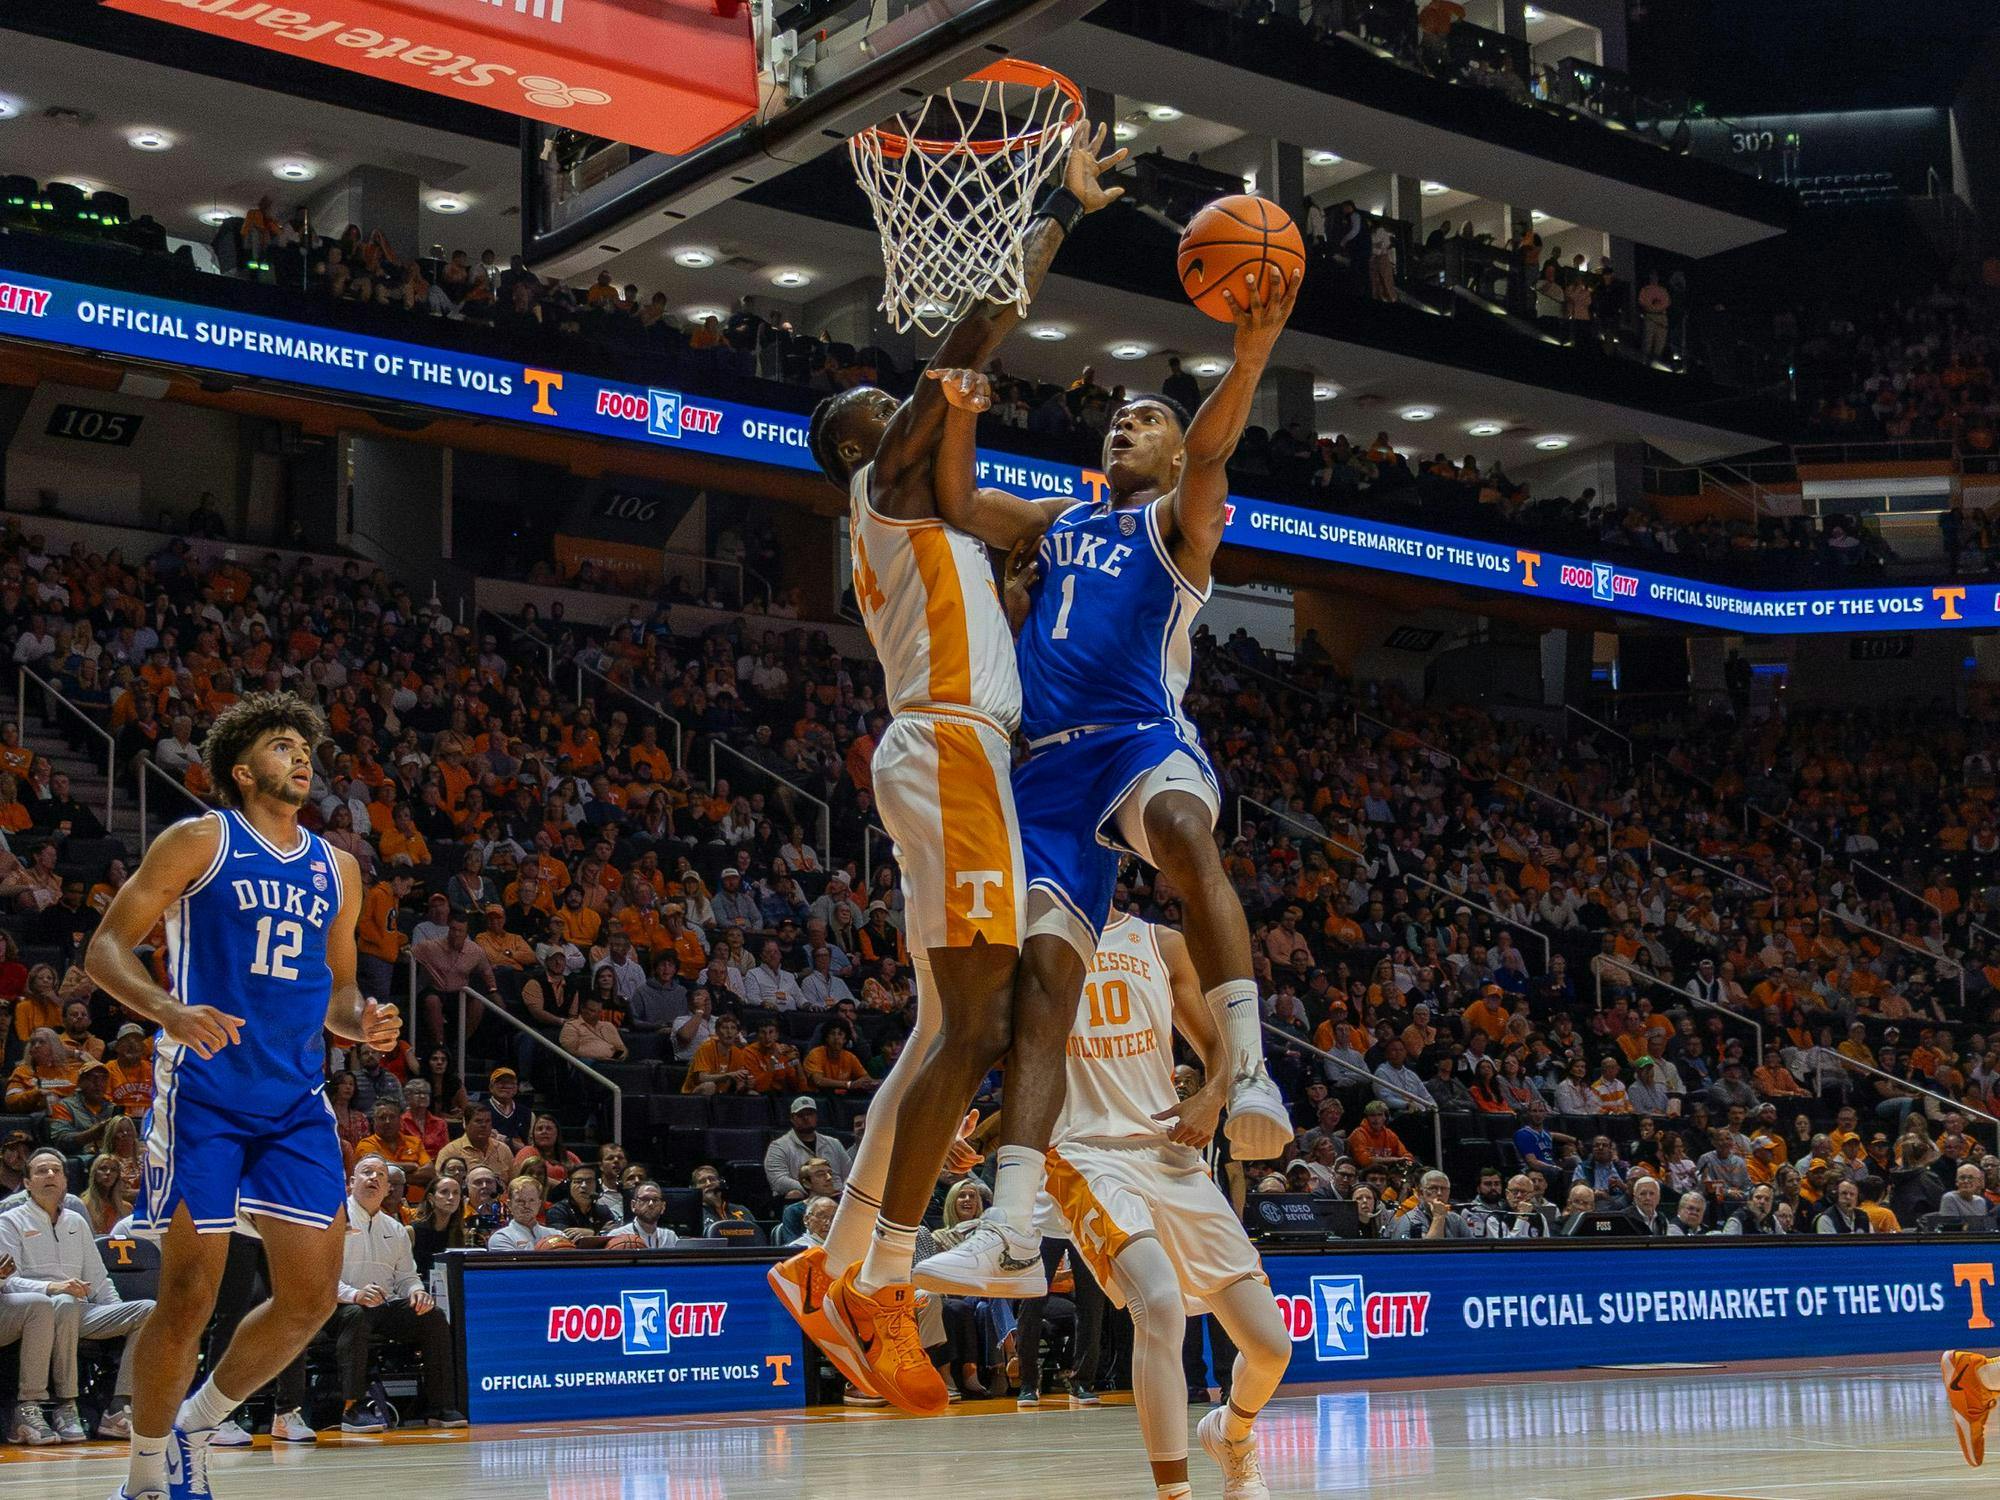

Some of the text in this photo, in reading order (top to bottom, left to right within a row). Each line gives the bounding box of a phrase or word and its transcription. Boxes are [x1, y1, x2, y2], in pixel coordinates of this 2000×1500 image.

[334, 28, 517, 87] State
[77, 301, 512, 395] OFFICIAL SUPERMARKET OF THE VOLS
[524, 368, 563, 416] T
[596, 389, 649, 421] FOOD
[680, 405, 723, 435] CITY
[60, 410, 128, 441] 105
[993, 464, 1027, 487] THE
[1031, 470, 1073, 494] VOLS
[604, 494, 661, 522] 106
[1250, 512, 1316, 539] OFFICIAL
[1319, 524, 1423, 557] SUPERMARKET
[1427, 544, 1445, 560] OF
[1447, 547, 1474, 567] THE
[1476, 552, 1511, 573] VOLS
[1560, 564, 1593, 589] FOOD
[1612, 574, 1638, 597] CITY
[1650, 583, 1924, 617] OFFICIAL SUPERMARKET OF THE VOLS
[1052, 574, 1076, 640] 1
[231, 878, 330, 929] DUKE
[956, 870, 1004, 919] T
[250, 915, 304, 981] 12
[1085, 979, 1132, 1028] 10
[1066, 1028, 1156, 1058] OLUNTEER
[1281, 1204, 1311, 1213] VIDEO
[1286, 1212, 1315, 1221] REVIEW
[108, 1240, 137, 1265] T
[1364, 1291, 1431, 1338] CITY
[1463, 1282, 1945, 1329] OFFICIAL SUPERMARKET OF THE VOLS
[1953, 1262, 1996, 1330] T
[548, 1304, 623, 1343] FOOD
[668, 1302, 728, 1338] CITY
[481, 1365, 760, 1392] OFFICIAL SUPERMARKET OF THE VOLS
[765, 1355, 792, 1387] T
